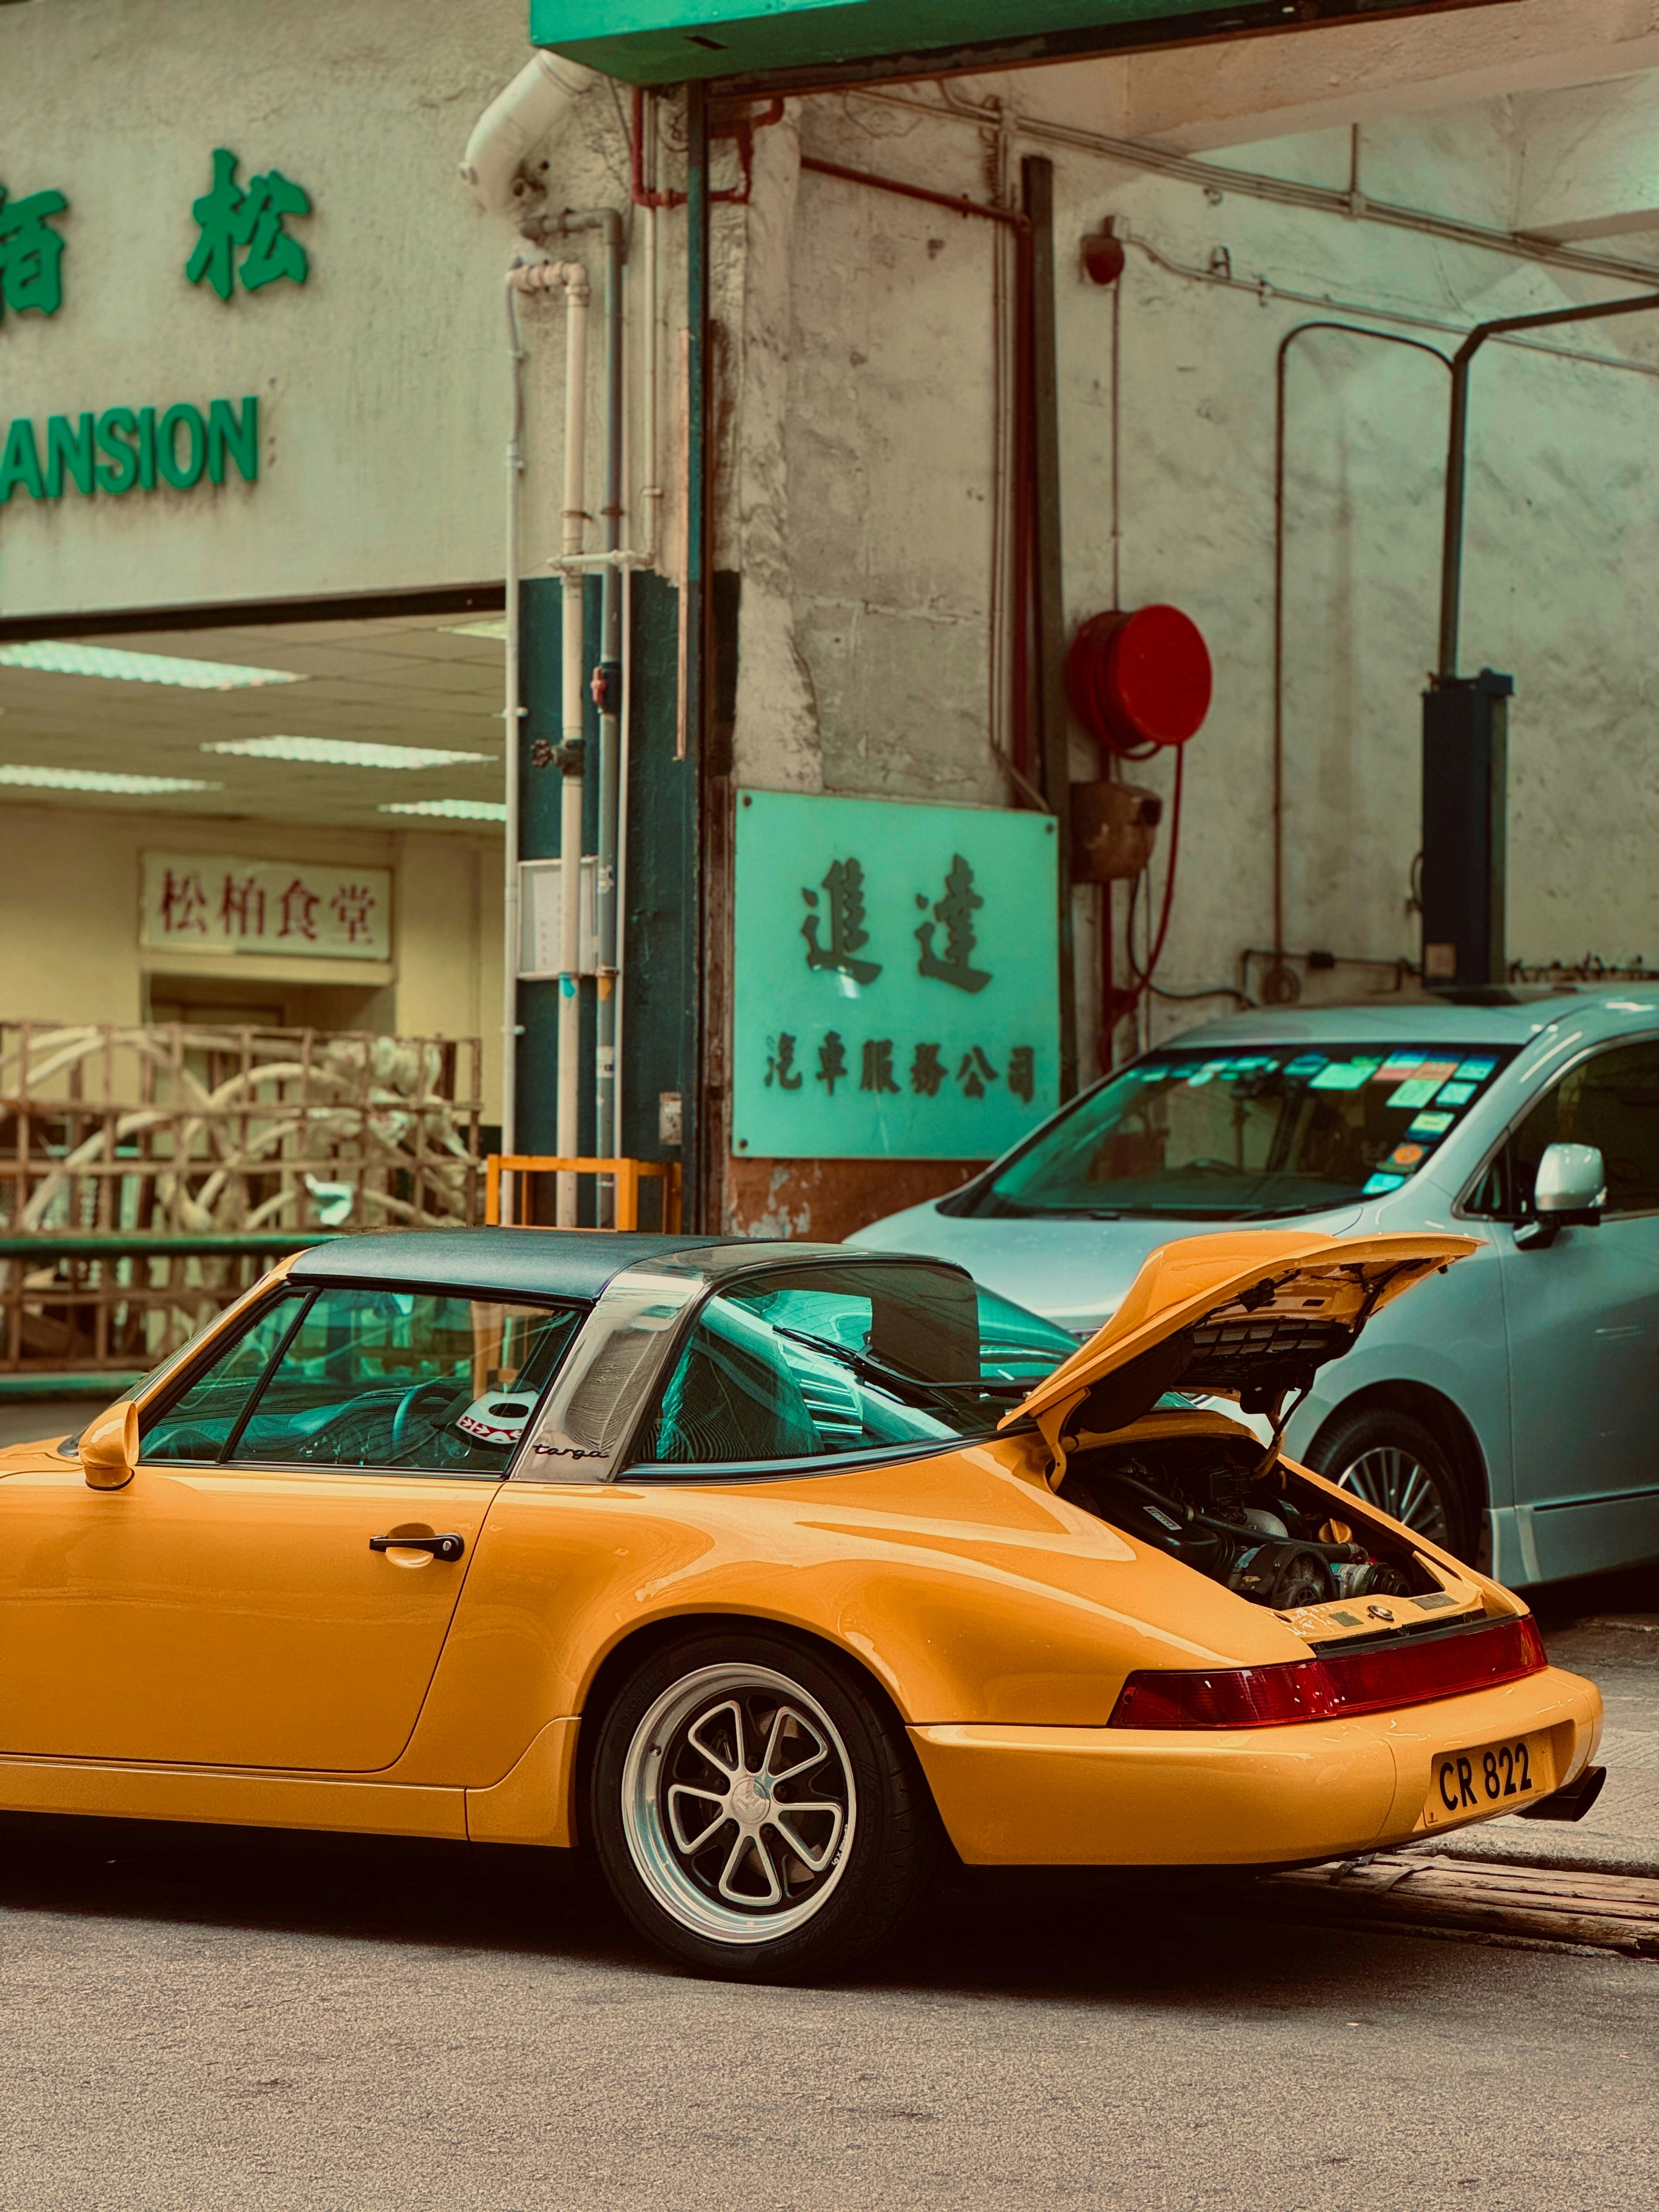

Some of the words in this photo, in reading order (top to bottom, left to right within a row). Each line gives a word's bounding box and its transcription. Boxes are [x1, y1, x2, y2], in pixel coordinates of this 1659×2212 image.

[160, 870, 376, 944] 松柏食堂
[764, 1030, 1035, 1105] 汽車服務公司
[533, 1443, 610, 1460] targa
[1439, 1757, 1478, 1811] CR
[1483, 1742, 1532, 1799] 822
